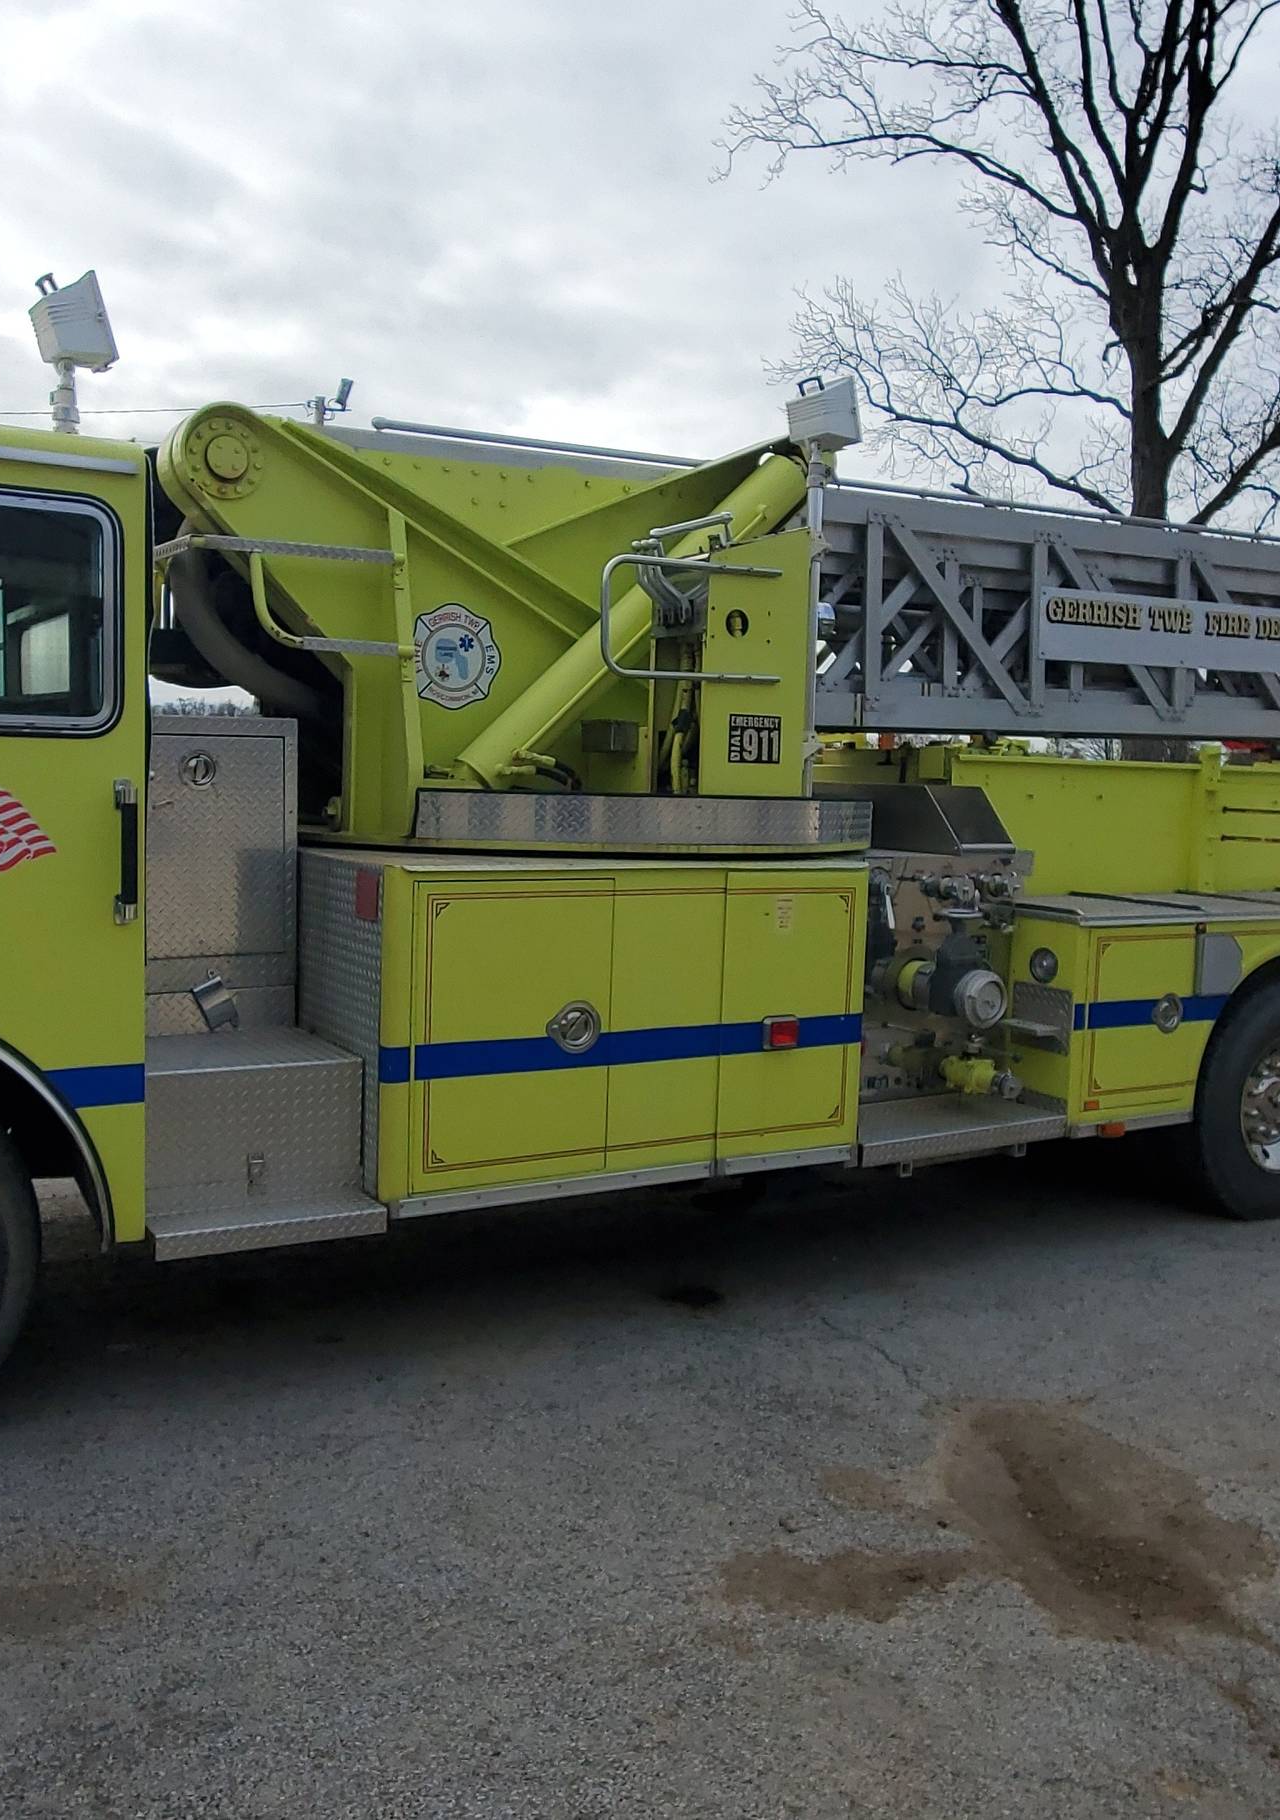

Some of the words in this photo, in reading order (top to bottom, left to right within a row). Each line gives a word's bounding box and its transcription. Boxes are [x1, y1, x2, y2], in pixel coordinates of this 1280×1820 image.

[428, 611, 462, 628] GERRISH
[1046, 597, 1143, 630] GERRISH
[1205, 608, 1251, 638] FIRE
[415, 640, 423, 674] FIRE
[485, 644, 496, 676] EMS
[731, 715, 780, 729] EMERGENCY
[730, 727, 741, 761] DIAL
[742, 728, 780, 762] 911
